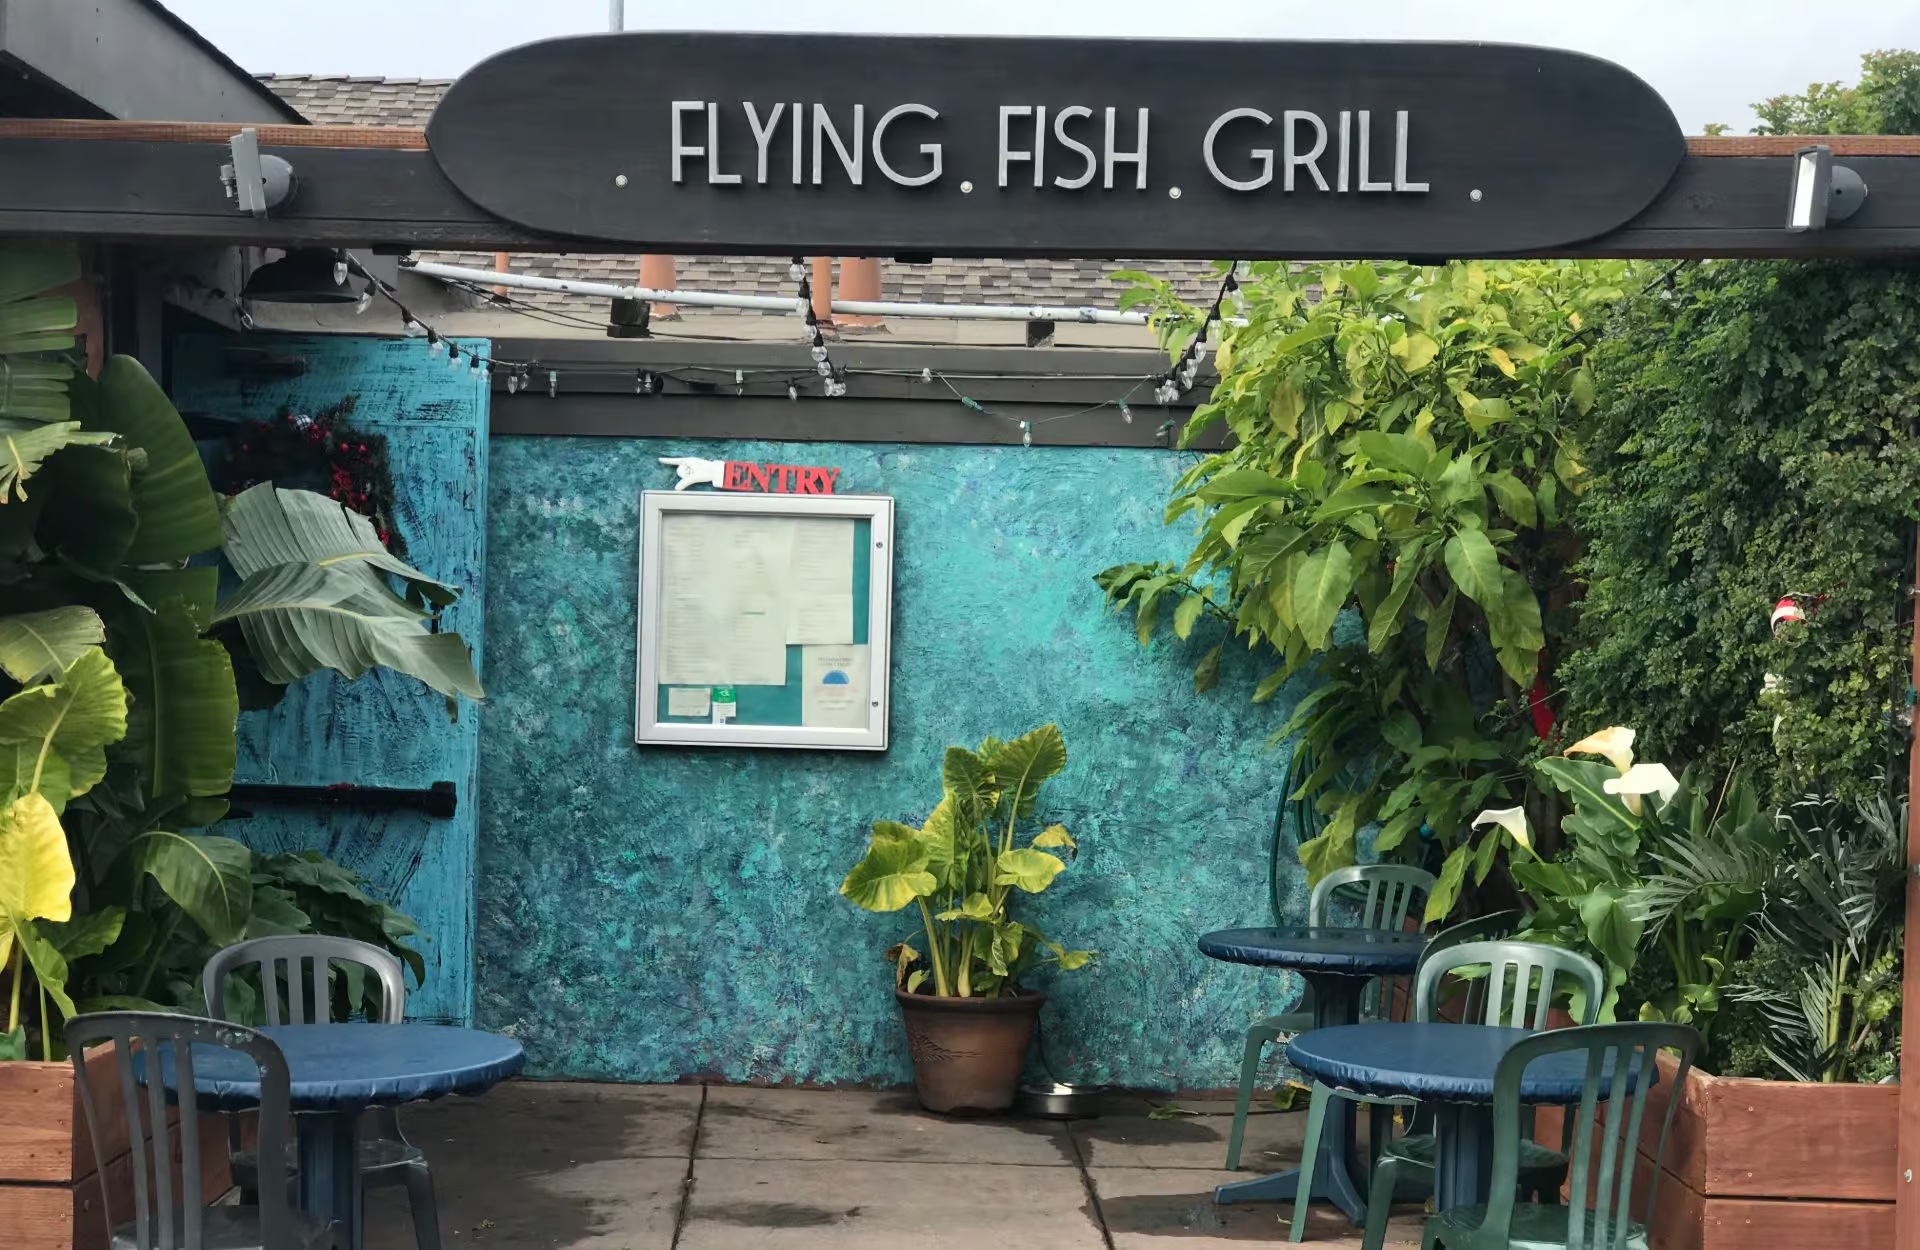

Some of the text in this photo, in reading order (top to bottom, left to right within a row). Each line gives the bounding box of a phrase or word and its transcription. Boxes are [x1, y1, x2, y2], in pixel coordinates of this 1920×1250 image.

[671, 100, 1430, 194] FLYING FISH GRILL
[723, 460, 840, 496] ENTRY
